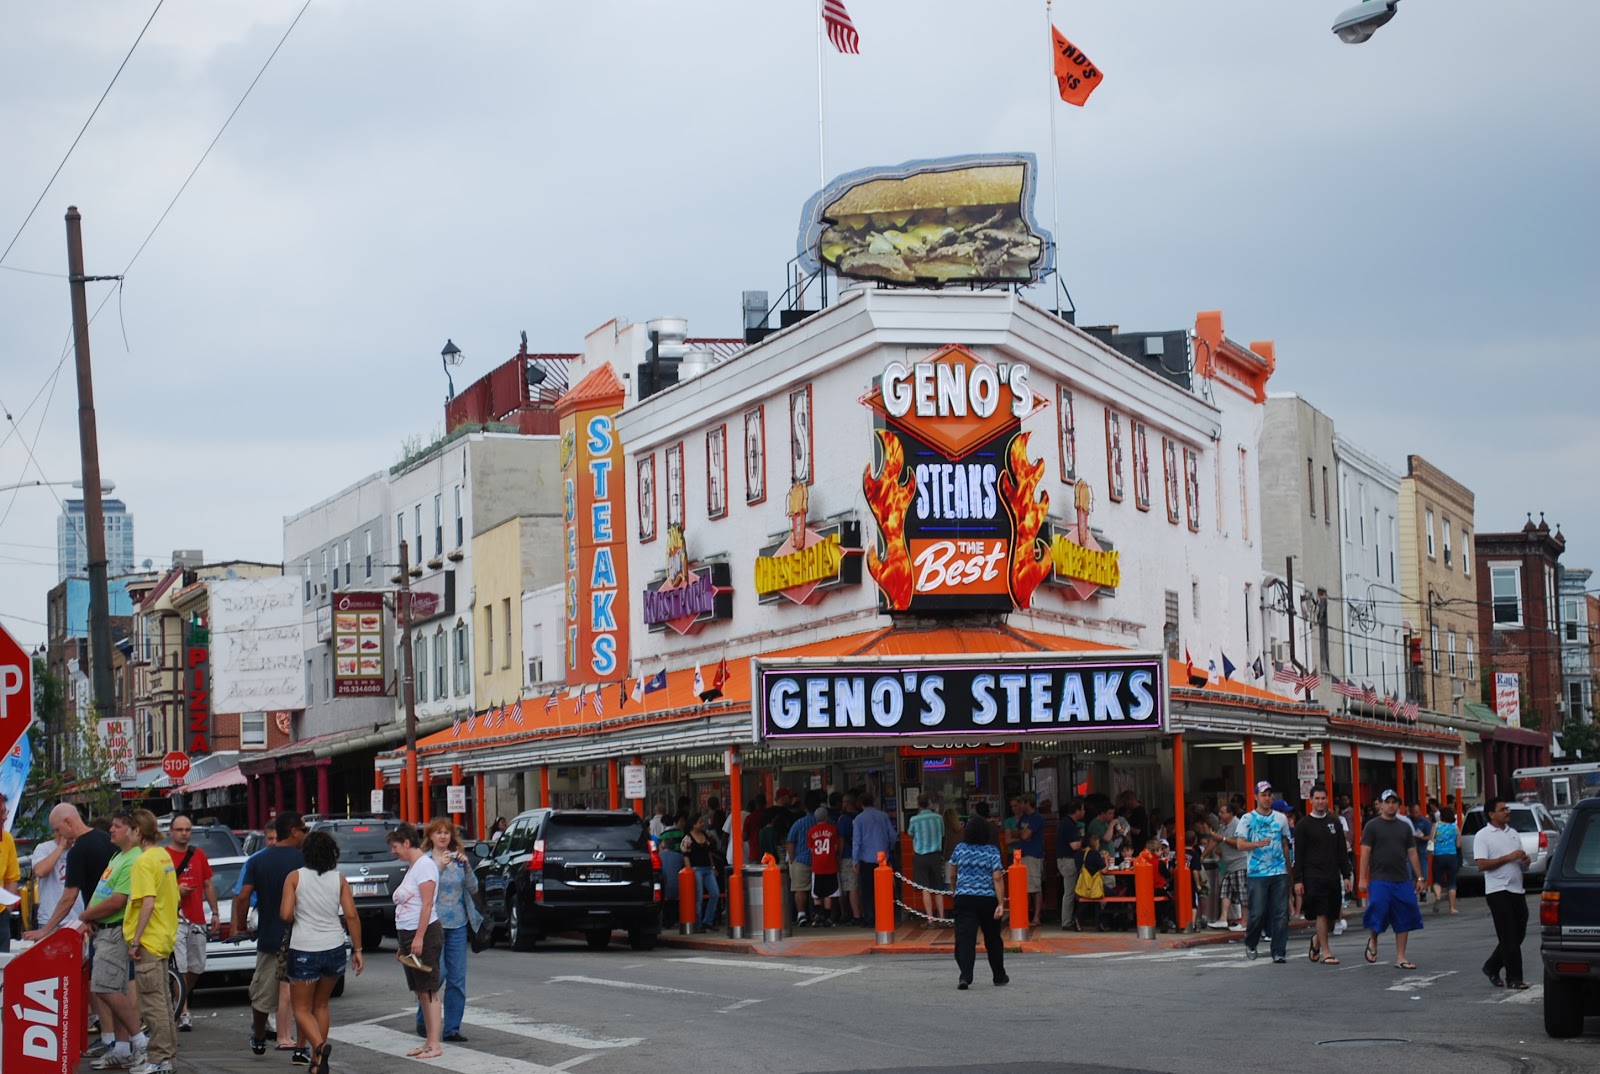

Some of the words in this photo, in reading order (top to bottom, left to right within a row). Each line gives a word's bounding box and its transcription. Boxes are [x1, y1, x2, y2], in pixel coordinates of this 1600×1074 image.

[881, 361, 1034, 418] GENO'S
[916, 463, 998, 520] STEAKS
[587, 415, 617, 676] STEAKS
[914, 541, 1006, 592] Best
[956, 541, 985, 555] THE
[643, 588, 678, 625] ROAST
[679, 574, 712, 617] PORK
[189, 648, 209, 753] PIZZA
[769, 672, 946, 729] GENO'S
[972, 670, 1154, 726] STEAKS
[1497, 674, 1518, 688] Ray's
[102, 749, 132, 758] ADOS
[107, 722, 122, 734] NO
[164, 760, 188, 770] STOP
[814, 838, 830, 855] 34
[12, 976, 60, 1062] DÍA
